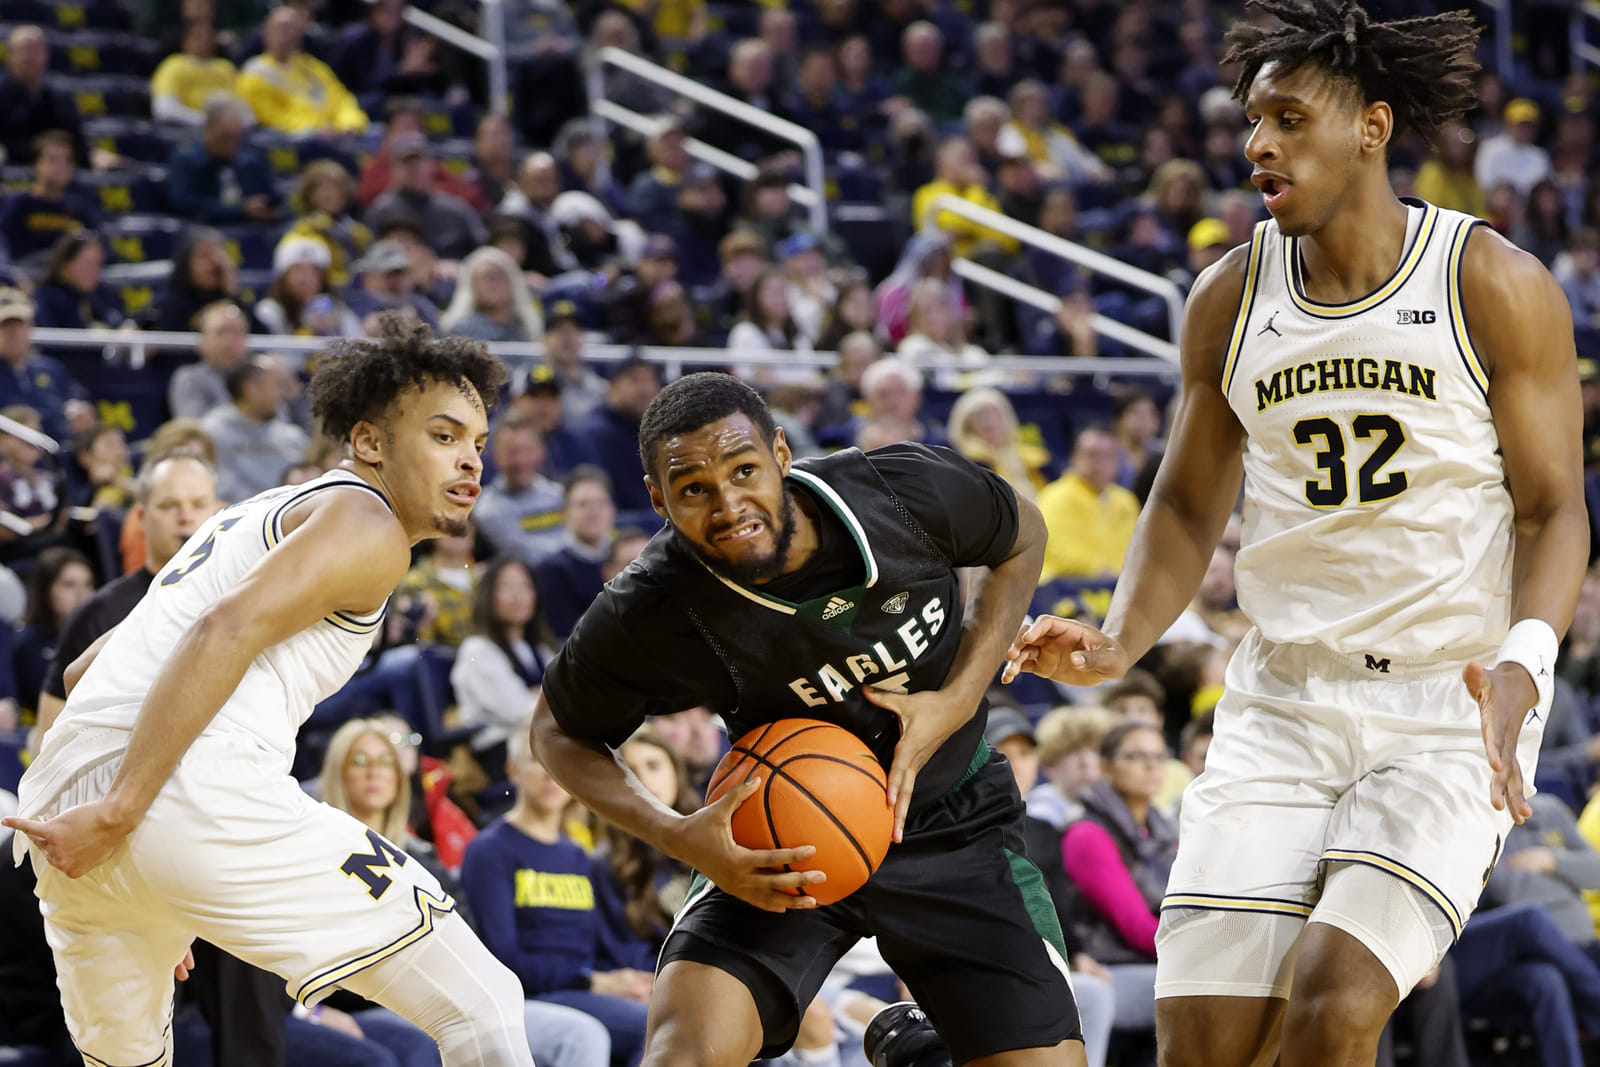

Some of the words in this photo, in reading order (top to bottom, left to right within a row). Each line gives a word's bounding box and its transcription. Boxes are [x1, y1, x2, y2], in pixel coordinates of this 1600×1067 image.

[1255, 358, 1437, 413] MICHIGAN
[1292, 412, 1409, 508] 32
[822, 601, 855, 620] adidas
[788, 597, 945, 708] EAGLES
[1364, 653, 1391, 673] M
[339, 827, 407, 902] M
